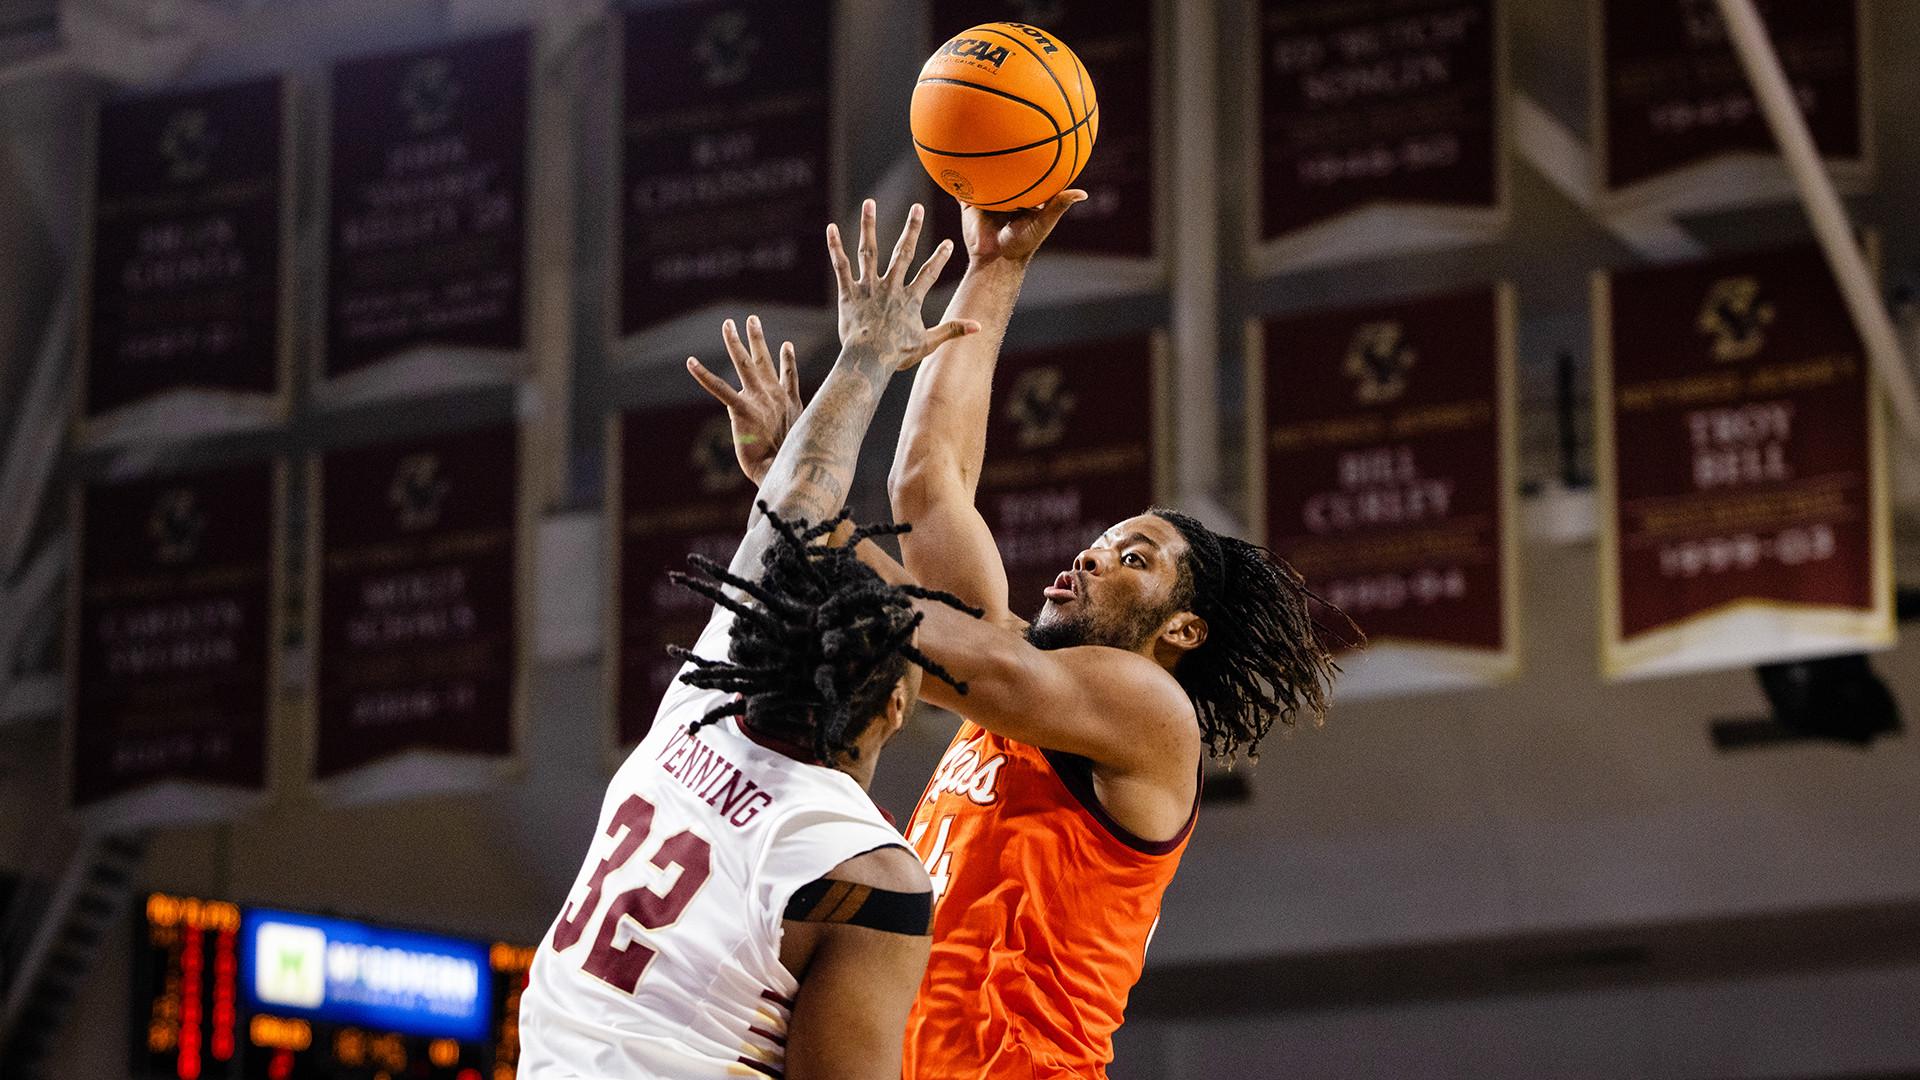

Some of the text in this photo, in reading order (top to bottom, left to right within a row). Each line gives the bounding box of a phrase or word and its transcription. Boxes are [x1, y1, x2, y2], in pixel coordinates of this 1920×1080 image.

[936, 39, 1011, 69] NCAA
[656, 724, 773, 828] VENNING
[552, 792, 714, 997] 32
